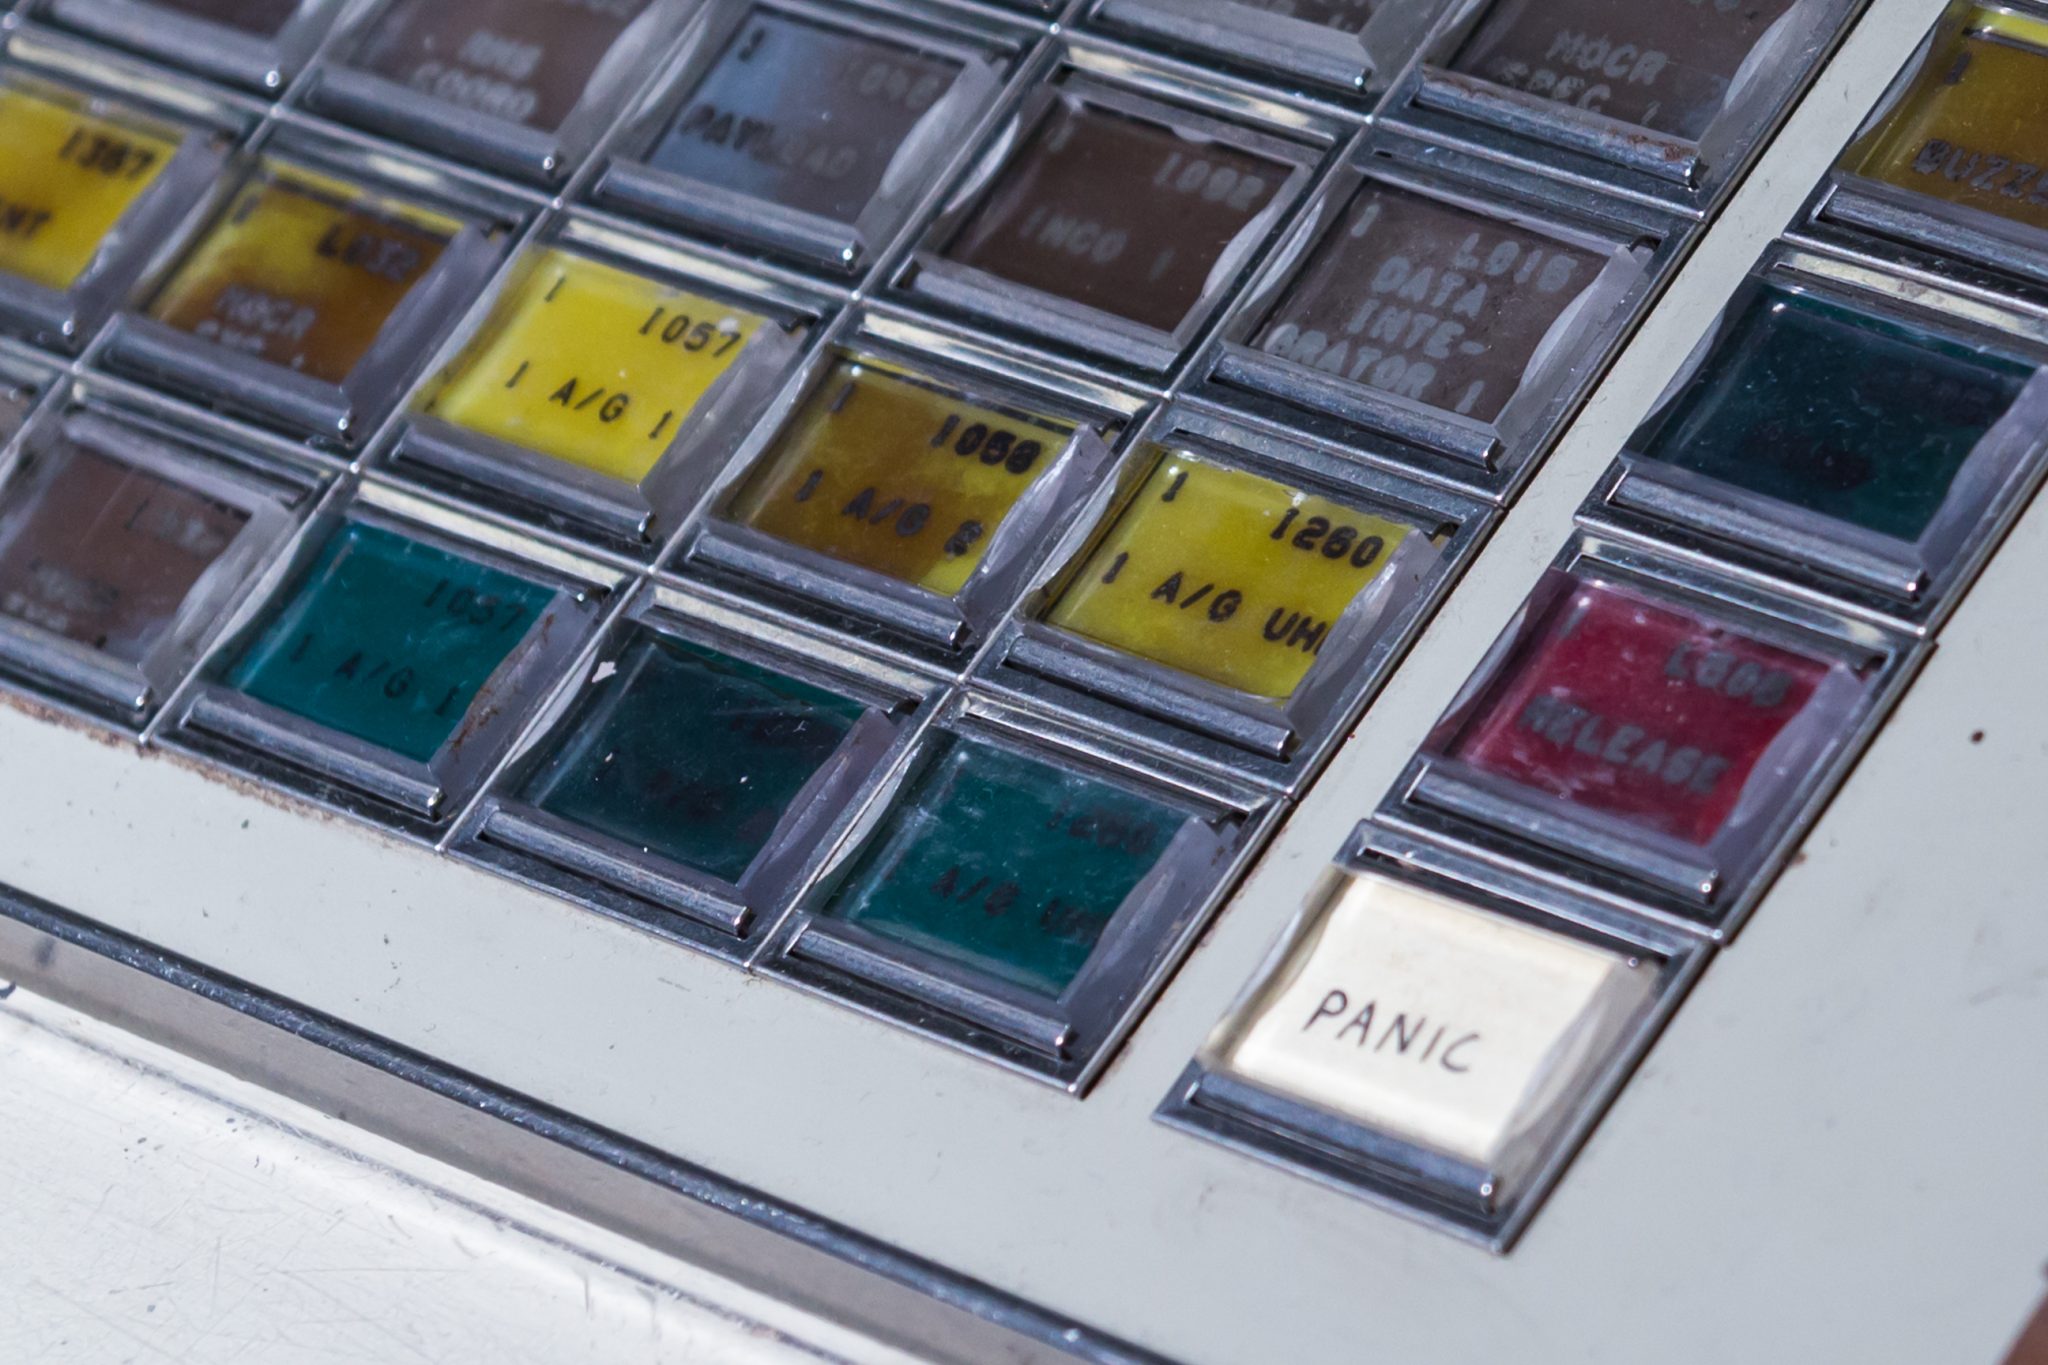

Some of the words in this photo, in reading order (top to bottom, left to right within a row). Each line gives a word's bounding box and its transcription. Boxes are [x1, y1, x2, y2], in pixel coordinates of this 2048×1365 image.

[1544, 29, 1688, 86] MOCR
[1351, 202, 1383, 240] 1
[543, 275, 567, 304] 1
[1370, 255, 1488, 322] DATA
[637, 305, 743, 360] 1057
[504, 359, 531, 389] 1
[547, 375, 632, 425] A/G
[648, 409, 674, 440] 1
[830, 380, 860, 414] 1
[1456, 379, 1486, 415] 1
[794, 468, 825, 504] 1
[1160, 470, 1189, 503] 1
[1270, 506, 1387, 570] 1260
[1100, 551, 1130, 585] 1
[1150, 569, 1245, 623] A/G
[288, 631, 317, 664] 1
[334, 649, 418, 700] A/G
[1518, 694, 1734, 796] RELEASE
[1301, 988, 1484, 1075] PANIC
